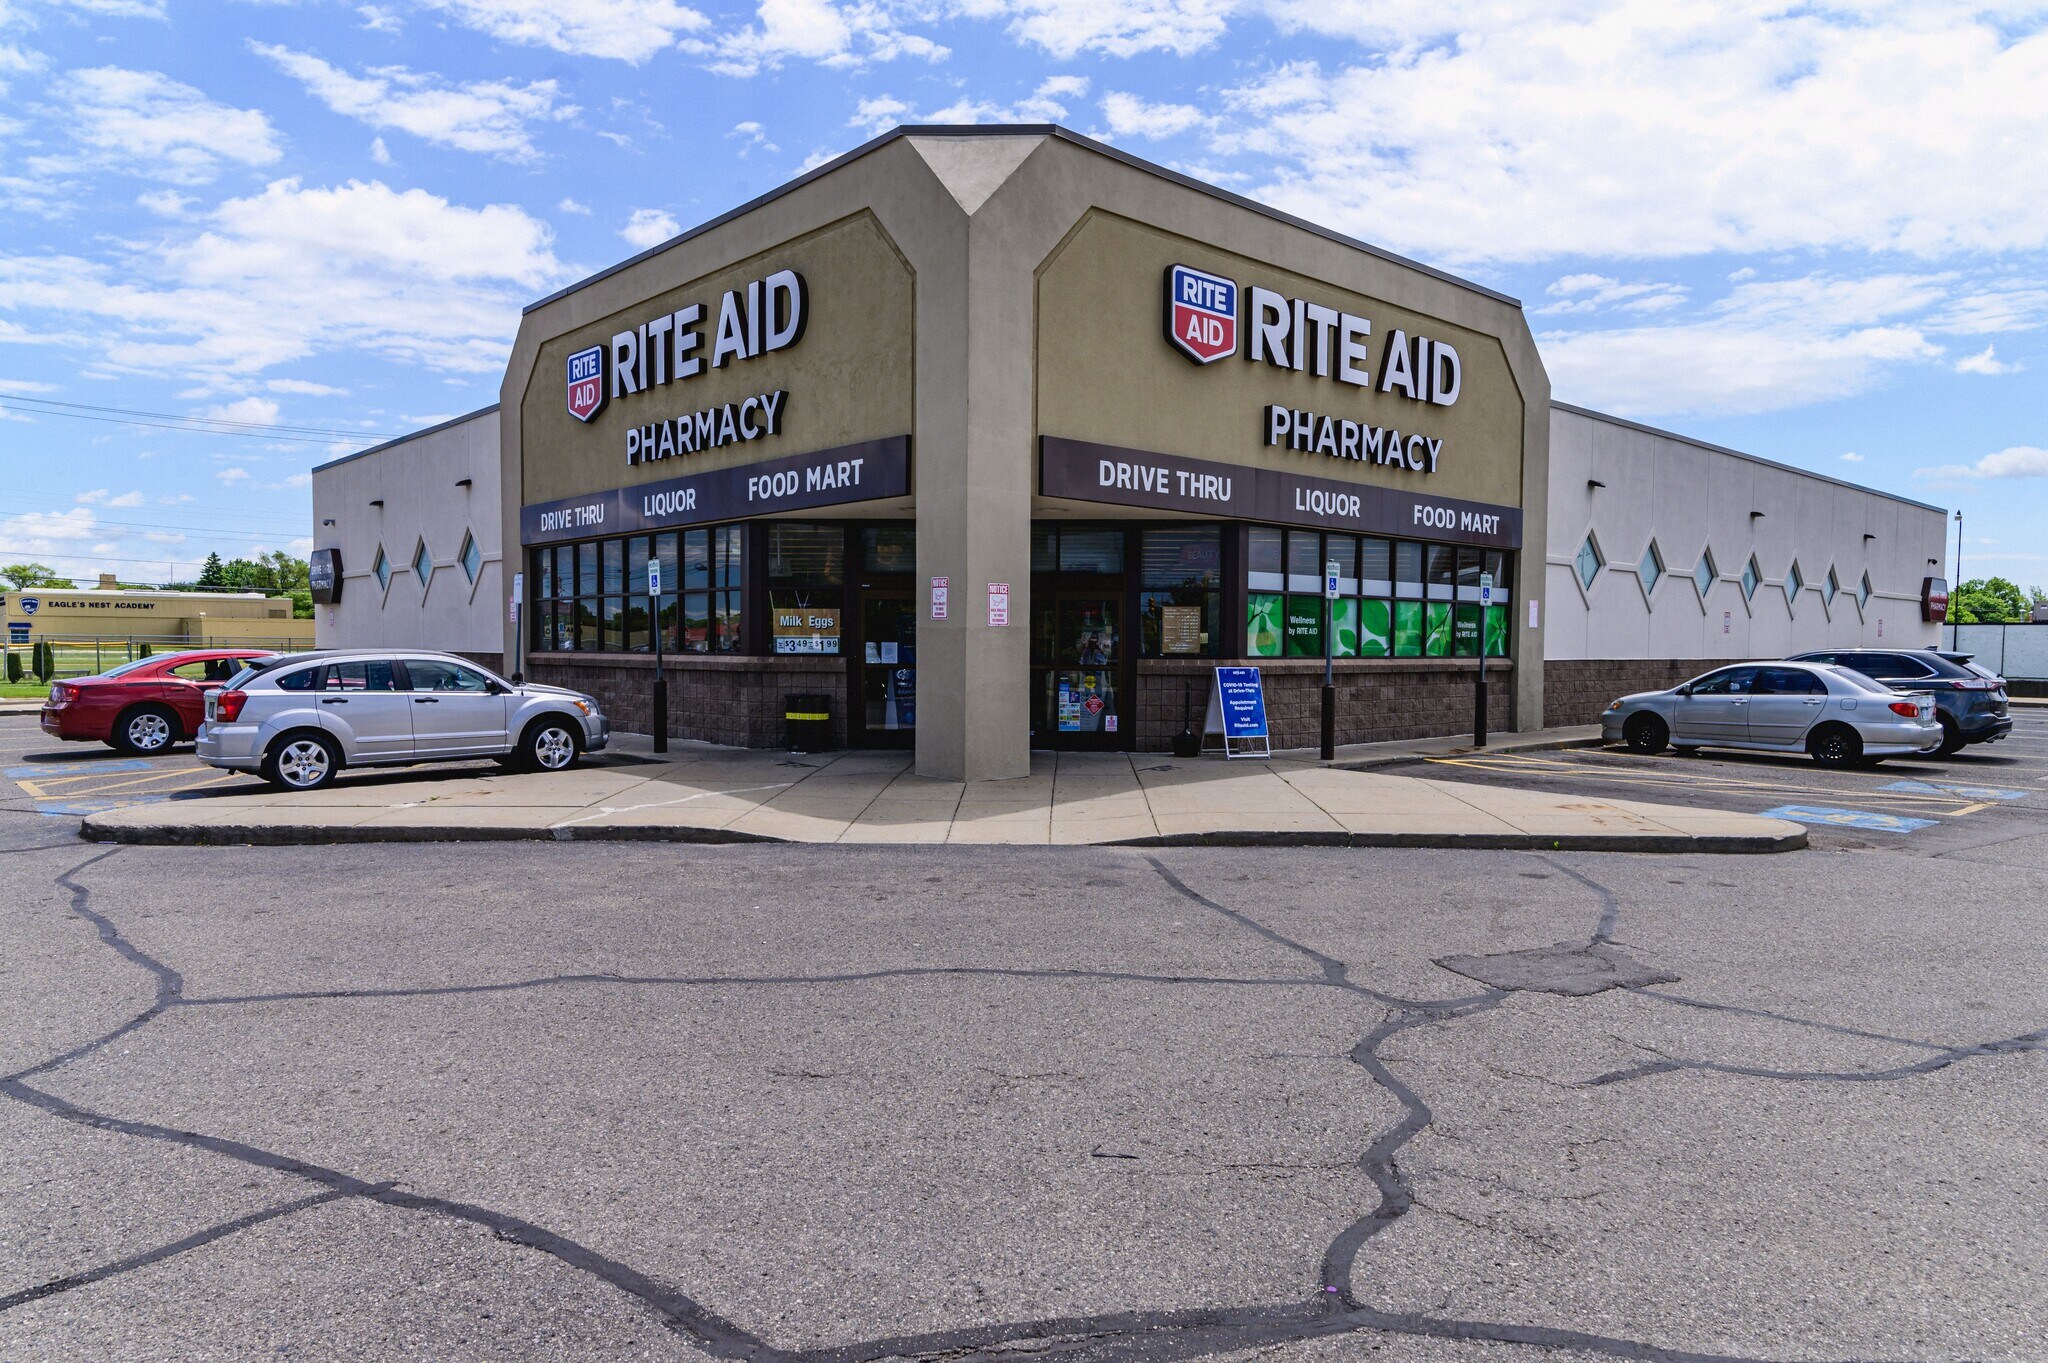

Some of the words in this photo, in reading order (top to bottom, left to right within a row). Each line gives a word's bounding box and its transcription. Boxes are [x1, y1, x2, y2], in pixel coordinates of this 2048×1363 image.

[1184, 276, 1227, 312] RITE
[612, 303, 706, 399] RITE
[712, 269, 807, 368] AID
[1186, 314, 1224, 347] AID
[1248, 285, 1372, 387] RITE
[1379, 329, 1462, 406] AID
[572, 353, 597, 379] RITE
[574, 383, 595, 409] AID
[627, 390, 787, 466] PHARMACY
[1267, 405, 1444, 473] PHARMACY
[748, 470, 799, 501] FOOD
[806, 459, 864, 493] MART
[1099, 460, 1169, 494] DRIVE
[1177, 470, 1232, 502] THRU
[541, 507, 572, 532] DRIVE
[575, 503, 604, 527] THRU
[644, 489, 696, 517] LIQUOR
[1295, 487, 1361, 518] LIQUOR
[1413, 504, 1456, 530] FOOD
[1461, 511, 1500, 535] MART
[989, 585, 1008, 593] NOTICE
[780, 615, 802, 626] Milk
[808, 615, 834, 629] Eggs
[1288, 627, 1295, 636] by
[1297, 627, 1308, 635] RITE
[1309, 627, 1318, 635] AID
[1289, 616, 1315, 624] Wellness
[1457, 621, 1477, 629] Wellness
